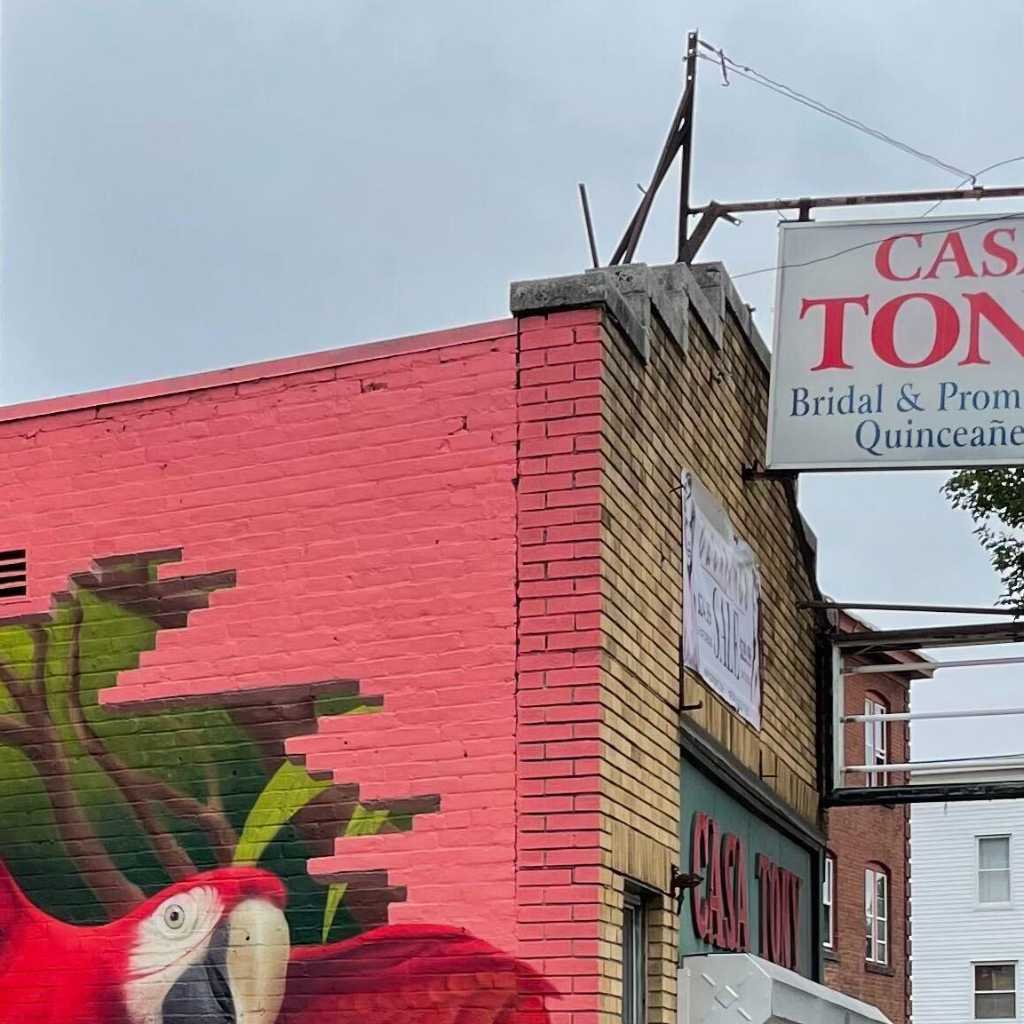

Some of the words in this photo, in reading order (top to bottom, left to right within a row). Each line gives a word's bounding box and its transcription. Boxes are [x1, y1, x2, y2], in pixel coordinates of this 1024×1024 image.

[874, 227, 1024, 282] CAS
[790, 383, 883, 417] Bridal
[896, 383, 925, 412] &
[937, 381, 1020, 411] Prom
[690, 811, 751, 952] CASA
[757, 852, 801, 973] TONY
